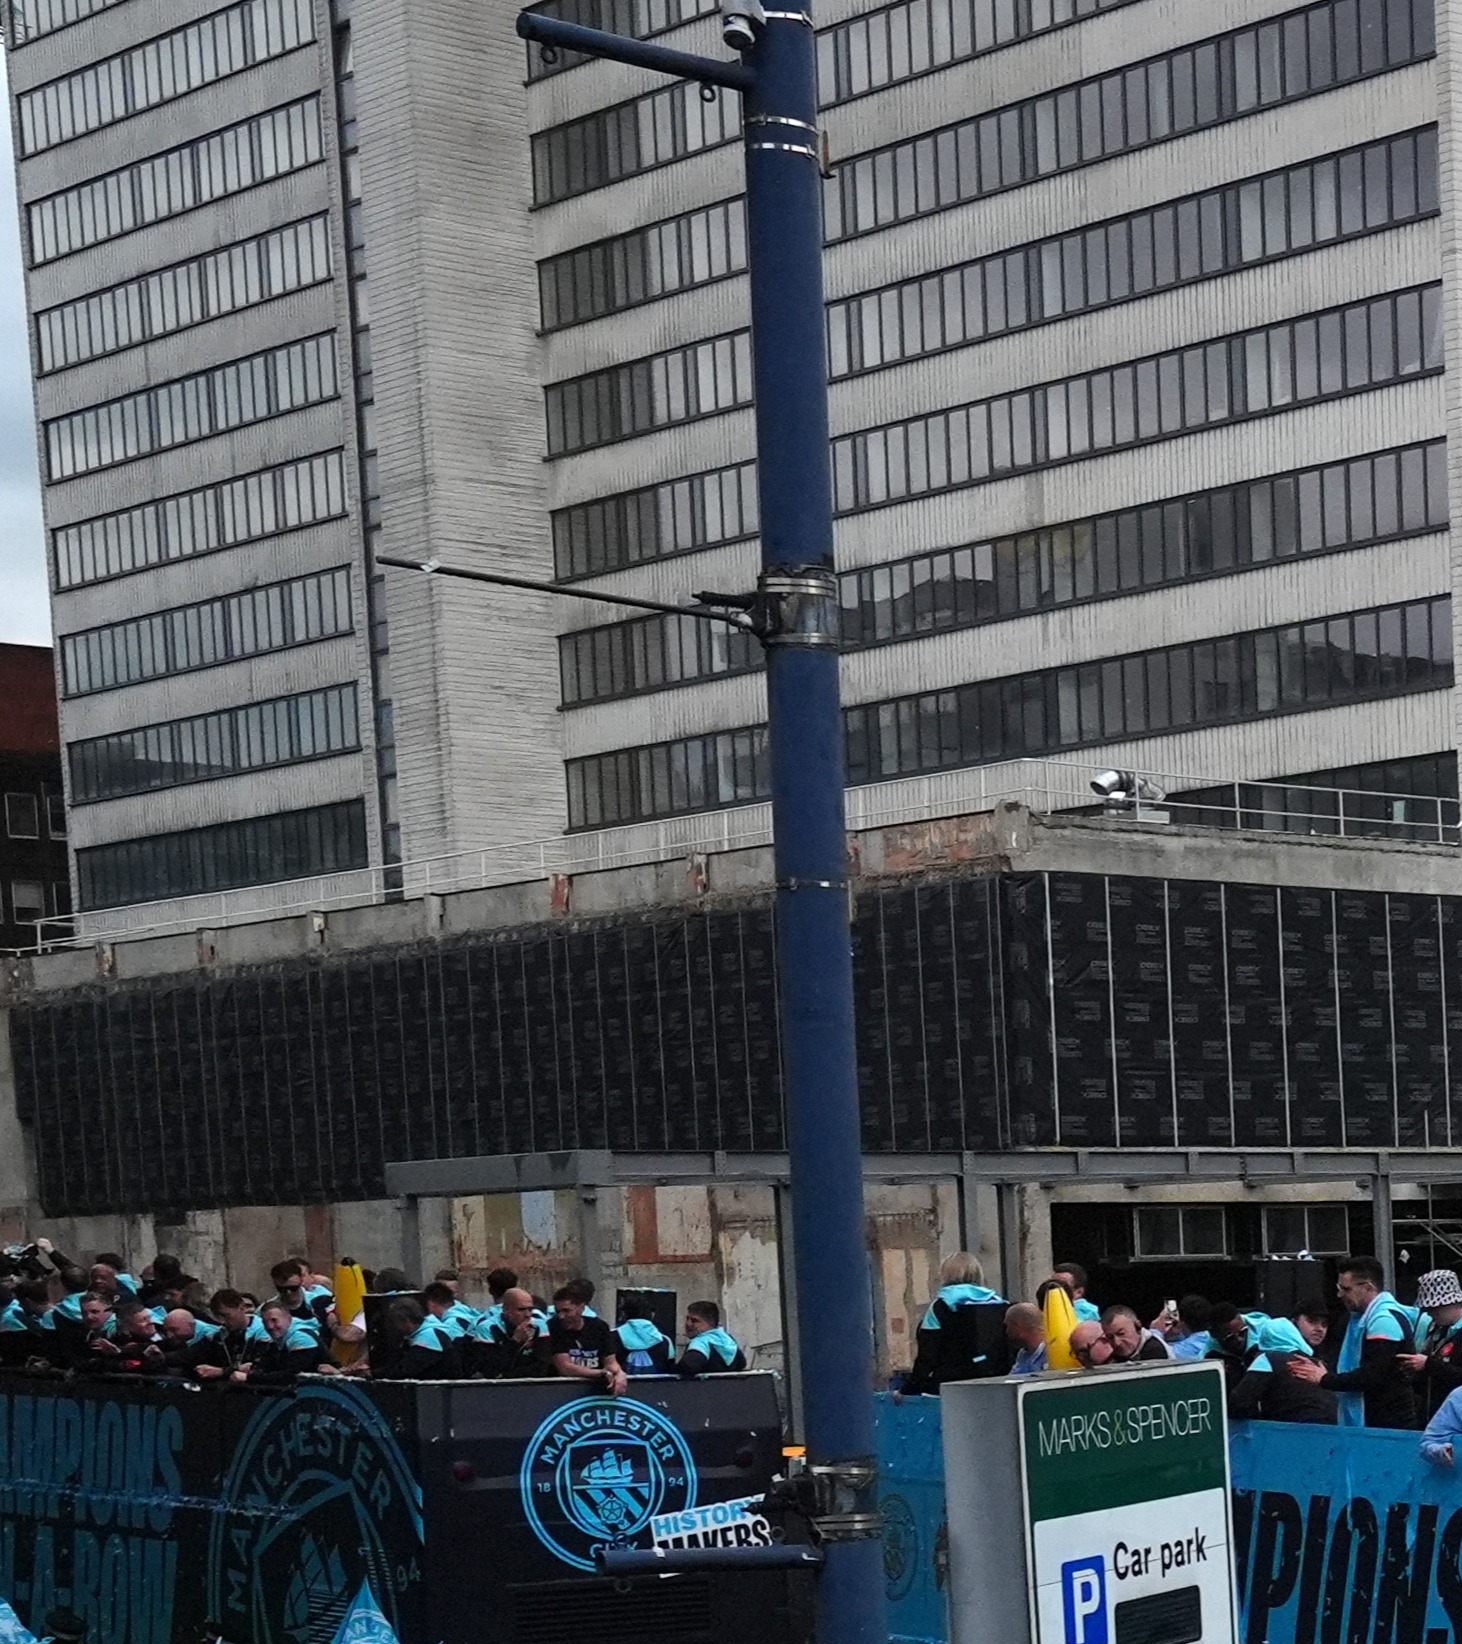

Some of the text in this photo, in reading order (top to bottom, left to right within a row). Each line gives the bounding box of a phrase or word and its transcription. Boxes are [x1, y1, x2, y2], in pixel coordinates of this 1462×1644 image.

[540, 1410, 675, 1465] MANCHESTER
[228, 1412, 391, 1613] MANCHESTER
[1113, 1527, 1207, 1580] Car park
[1072, 1568, 1100, 1644] P
